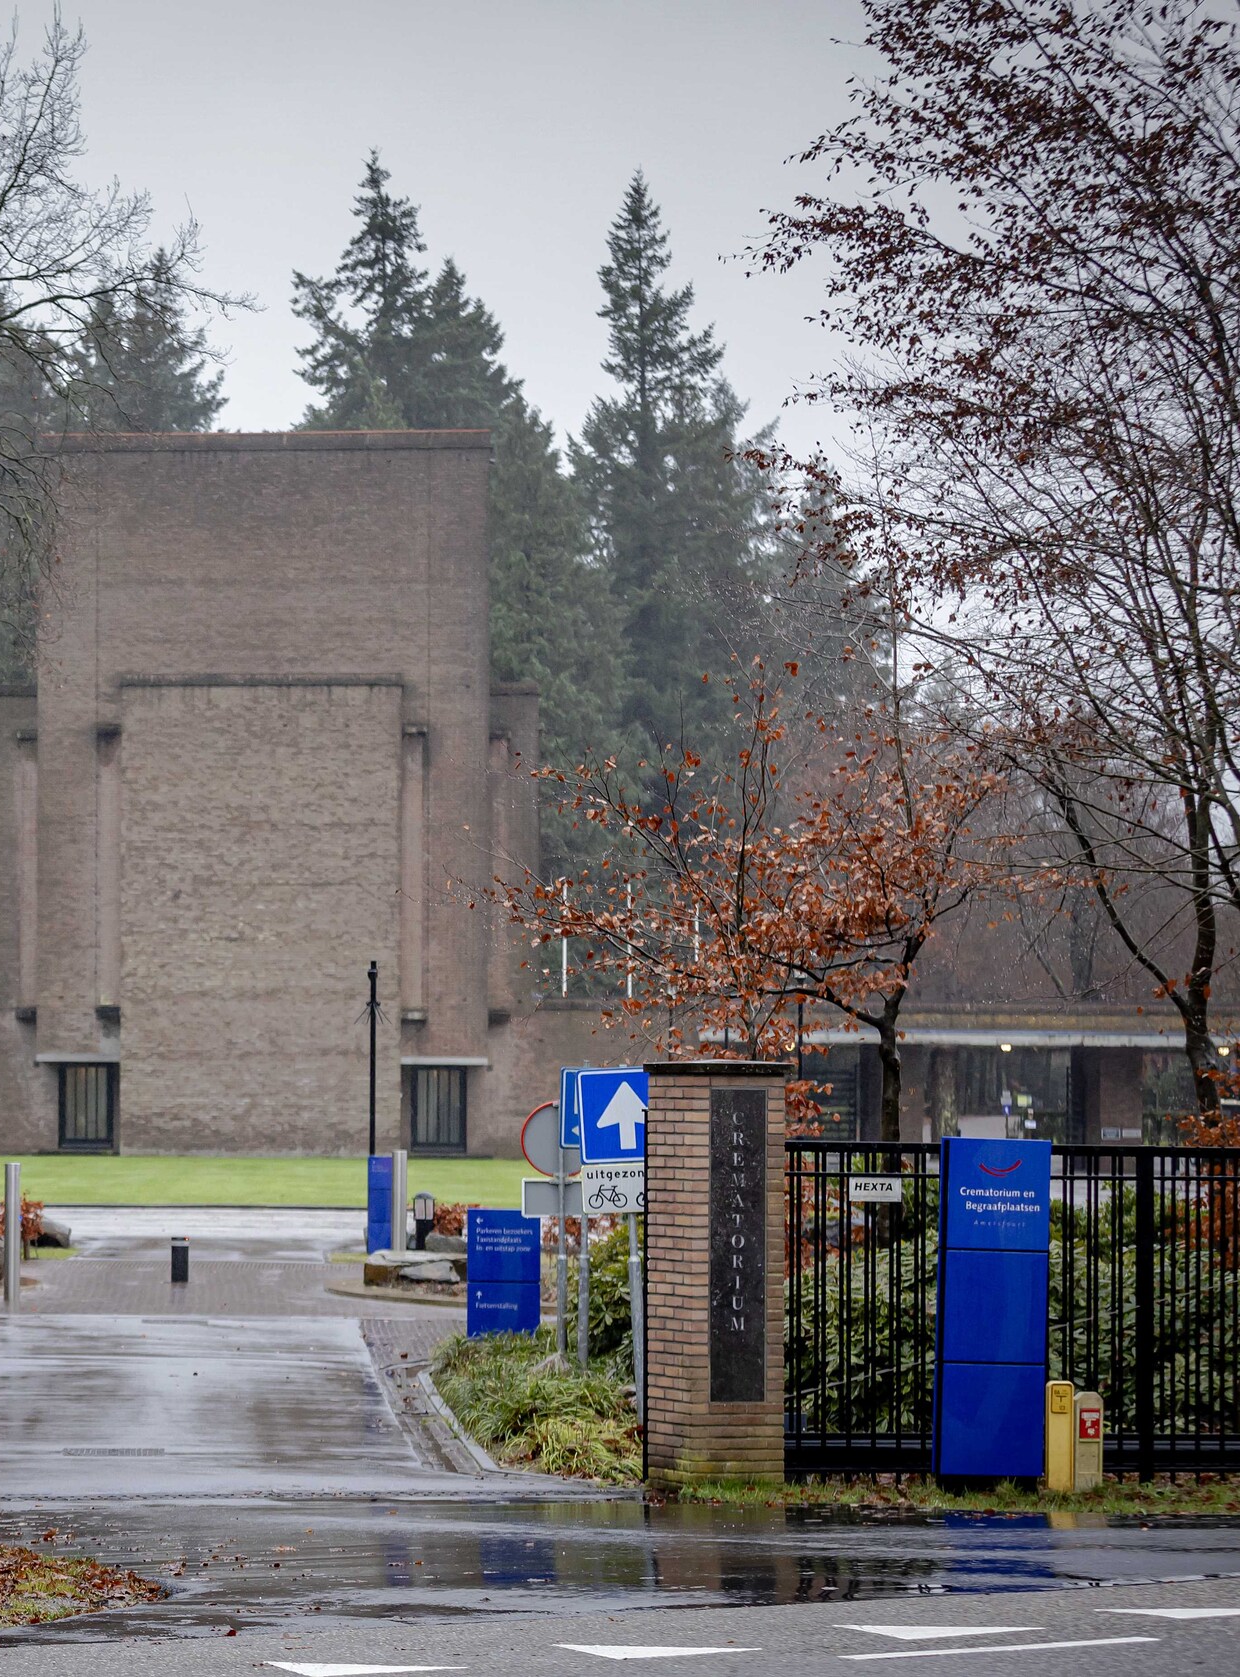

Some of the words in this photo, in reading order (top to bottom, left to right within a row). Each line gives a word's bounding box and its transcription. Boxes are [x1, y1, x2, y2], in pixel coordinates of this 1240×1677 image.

[854, 1182, 893, 1192] HEXTA
[959, 1186, 1021, 1198] Crematorium
[1023, 1190, 1035, 1198] en
[965, 1200, 1040, 1213] Begraafplaatsen
[730, 1111, 745, 1331] CREMATORIUM
[476, 1227, 502, 1235] Parkeren
[503, 1227, 533, 1236] bezoekers
[476, 1236, 522, 1244] Taxistandplaats
[475, 1302, 518, 1311] Fietsenstalling
